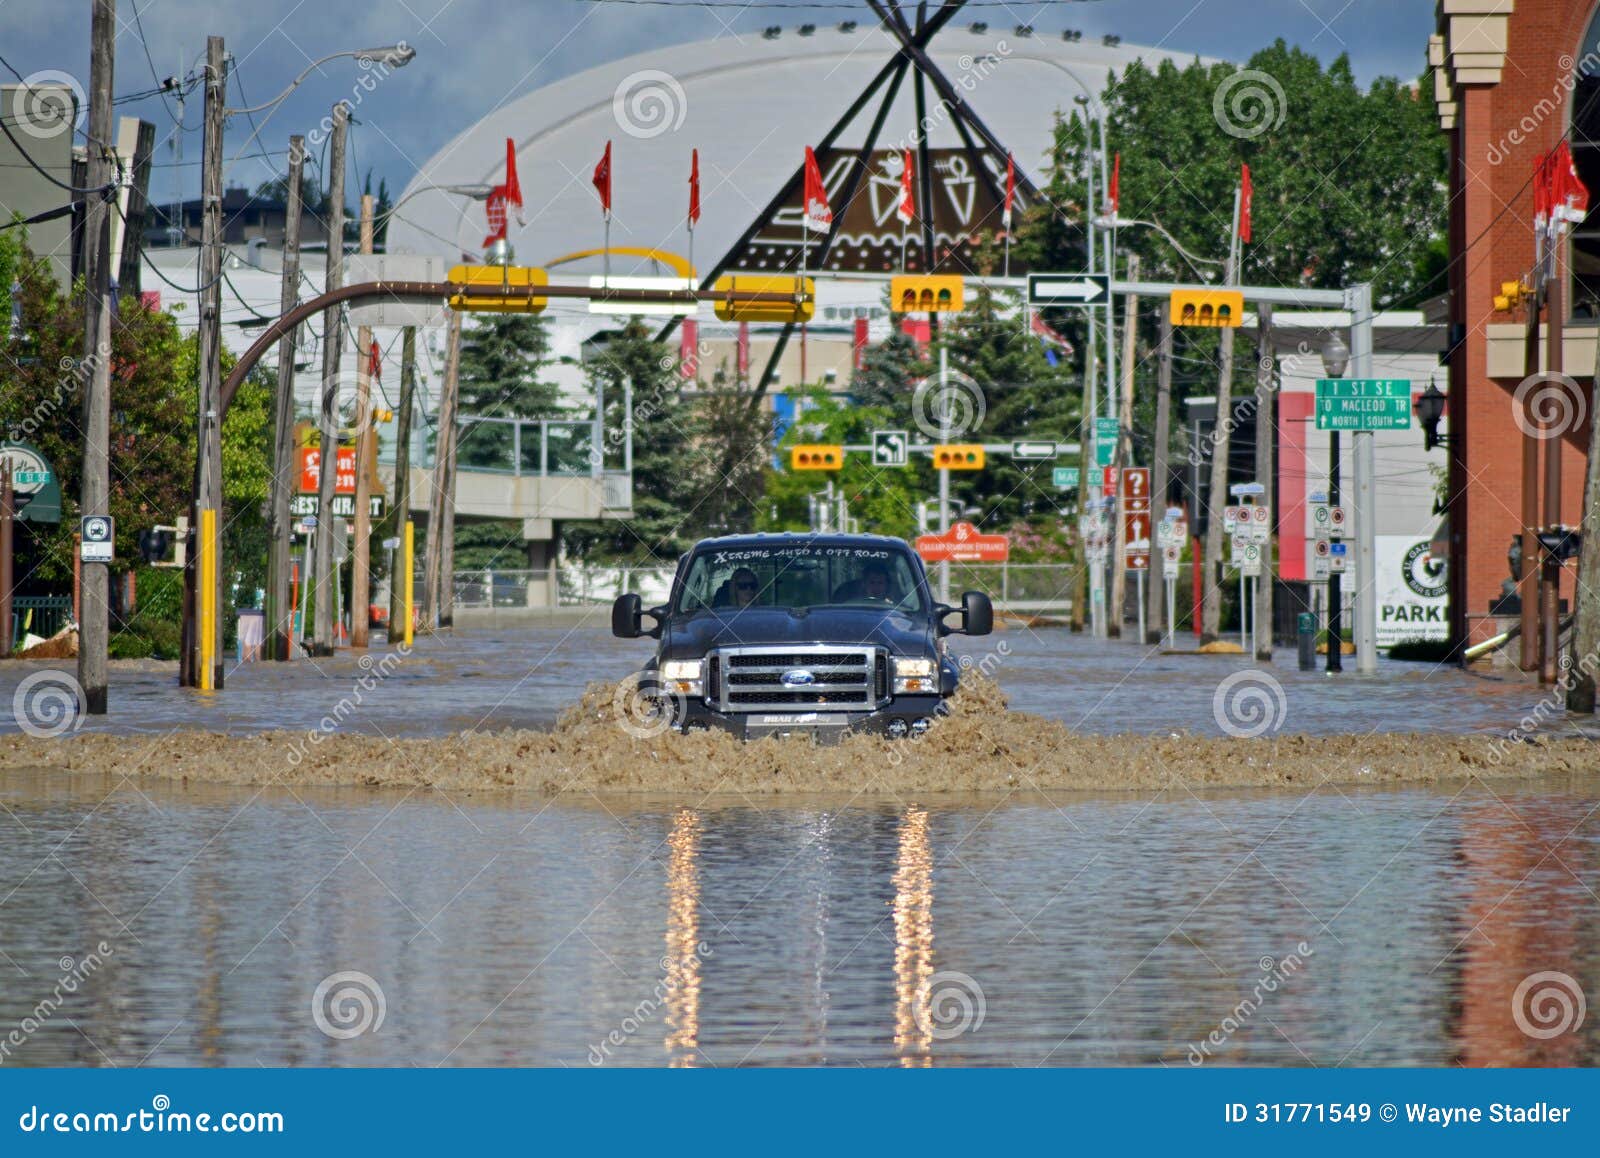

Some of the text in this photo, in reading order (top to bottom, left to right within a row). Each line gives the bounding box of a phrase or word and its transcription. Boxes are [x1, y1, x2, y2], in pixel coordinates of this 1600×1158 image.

[1333, 382, 1393, 395] 1 ST SE
[1342, 400, 1385, 411] MACLEOD
[1395, 400, 1407, 411] TR
[1332, 415, 1393, 426] NORTH SOUTH
[854, 549, 889, 559] ROAD
